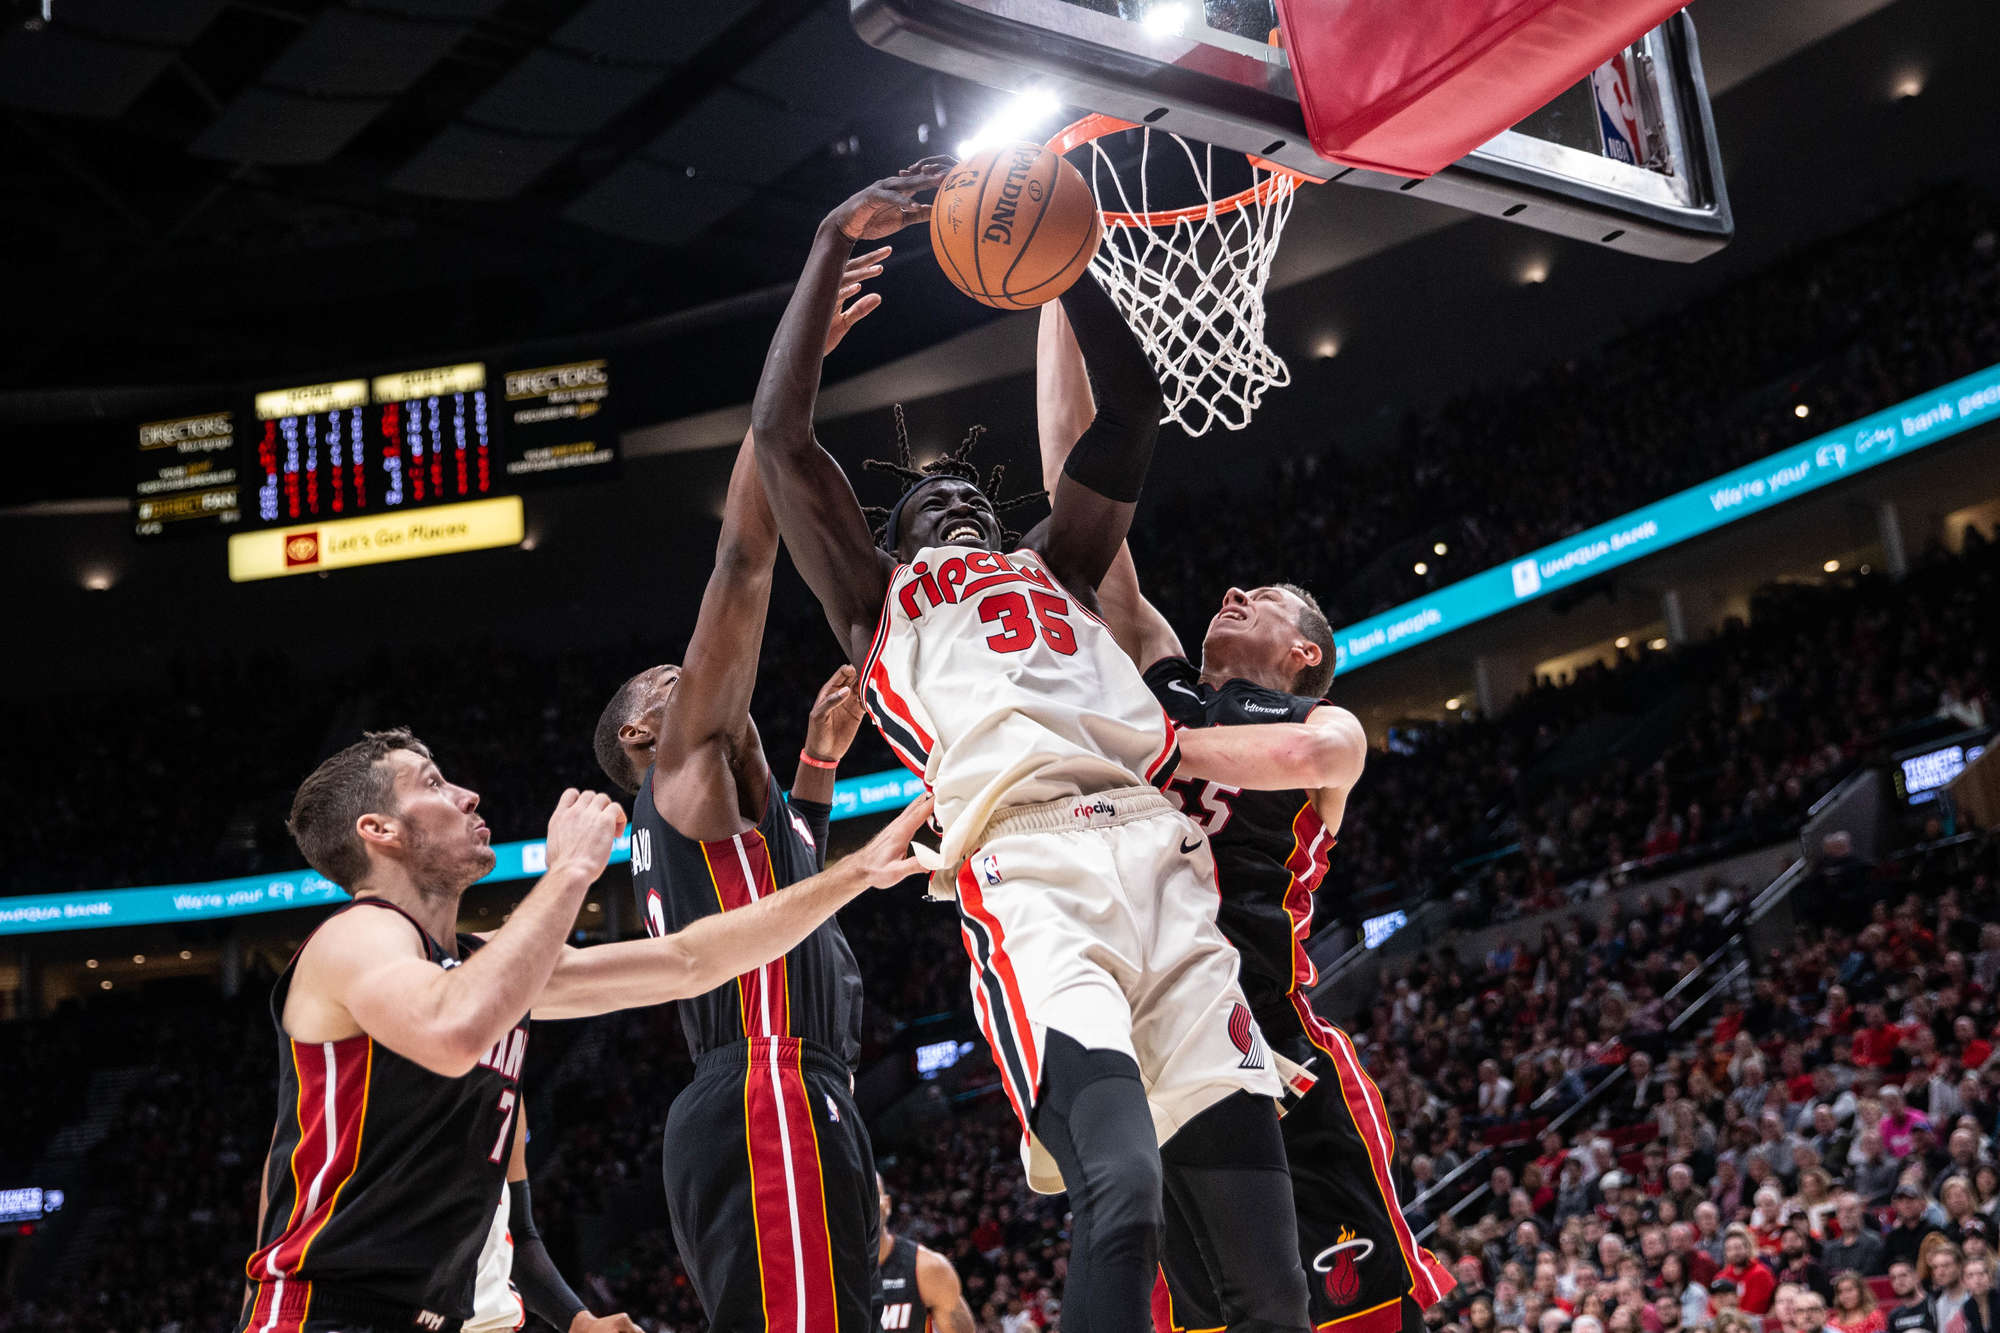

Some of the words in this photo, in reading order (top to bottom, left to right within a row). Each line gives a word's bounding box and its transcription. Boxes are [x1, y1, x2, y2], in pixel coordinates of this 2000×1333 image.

[1608, 137, 1630, 161] NBA
[981, 143, 1042, 246] SPALDING
[1767, 460, 1810, 493] your
[1901, 402, 1953, 437] bank
[375, 529, 402, 547] Go
[1540, 540, 1609, 578] UMPQUA
[1610, 520, 1657, 551] BANK
[899, 552, 1058, 621] ripciy
[978, 589, 1078, 656] 35
[1349, 629, 1386, 657] bank
[860, 780, 901, 803] bank
[64, 902, 112, 918] BANK
[226, 888, 263, 908] your
[488, 1088, 516, 1166] 7
